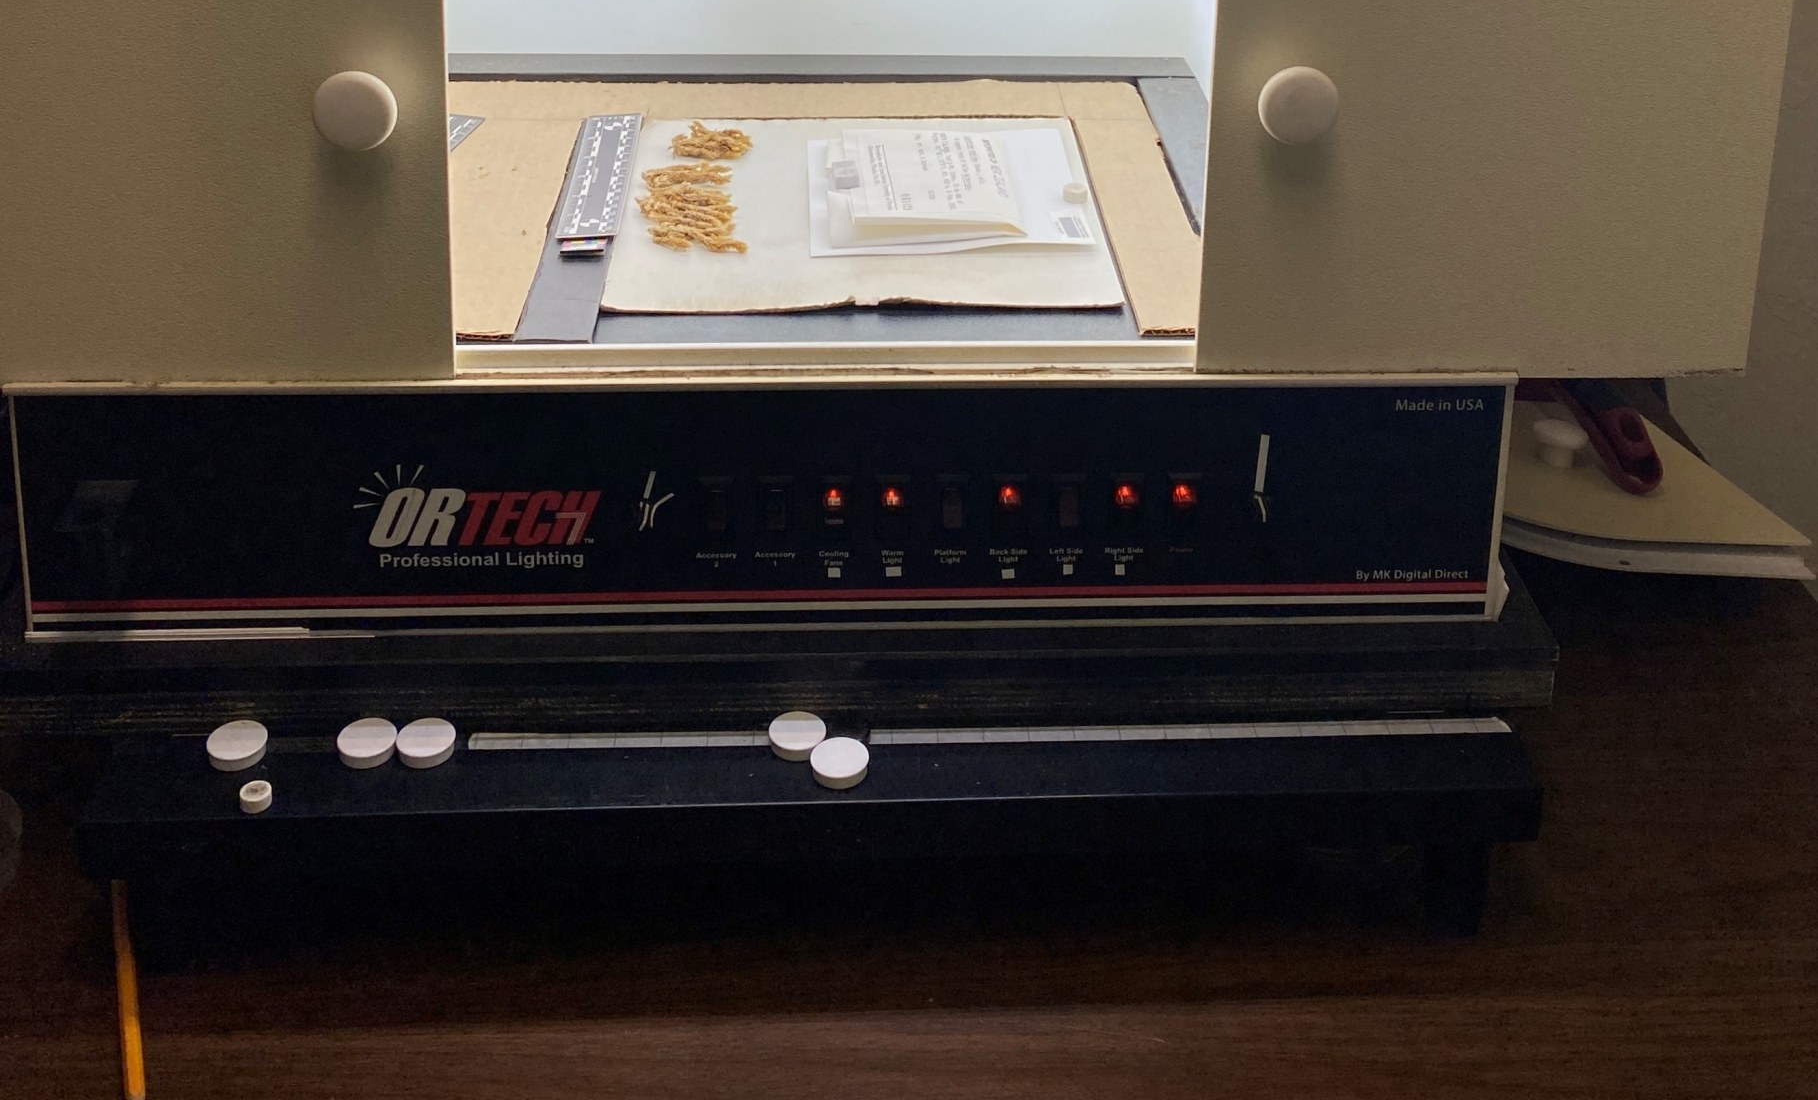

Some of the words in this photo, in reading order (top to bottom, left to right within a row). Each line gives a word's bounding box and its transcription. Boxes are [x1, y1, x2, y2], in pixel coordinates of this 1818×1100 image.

[1395, 399, 1434, 411] Made
[1438, 398, 1451, 411] in
[1456, 399, 1484, 411] USA
[368, 487, 602, 548] ORTECH
[754, 550, 797, 559] Accessory
[818, 550, 850, 558] Cooling
[881, 549, 904, 557] Warm
[990, 548, 1009, 556] Back
[1104, 547, 1125, 555] Right
[696, 552, 738, 560] Accessory
[998, 556, 1018, 564] Light
[1056, 555, 1076, 563] Light
[1113, 554, 1134, 562] Light
[379, 552, 500, 568] Professional
[506, 552, 584, 569] Lighting
[882, 556, 903, 565] Light
[940, 556, 960, 565] Light
[1356, 570, 1370, 581] By
[1373, 569, 1391, 580] MK
[1394, 569, 1432, 582] Digital
[1434, 569, 1469, 580] Direct
